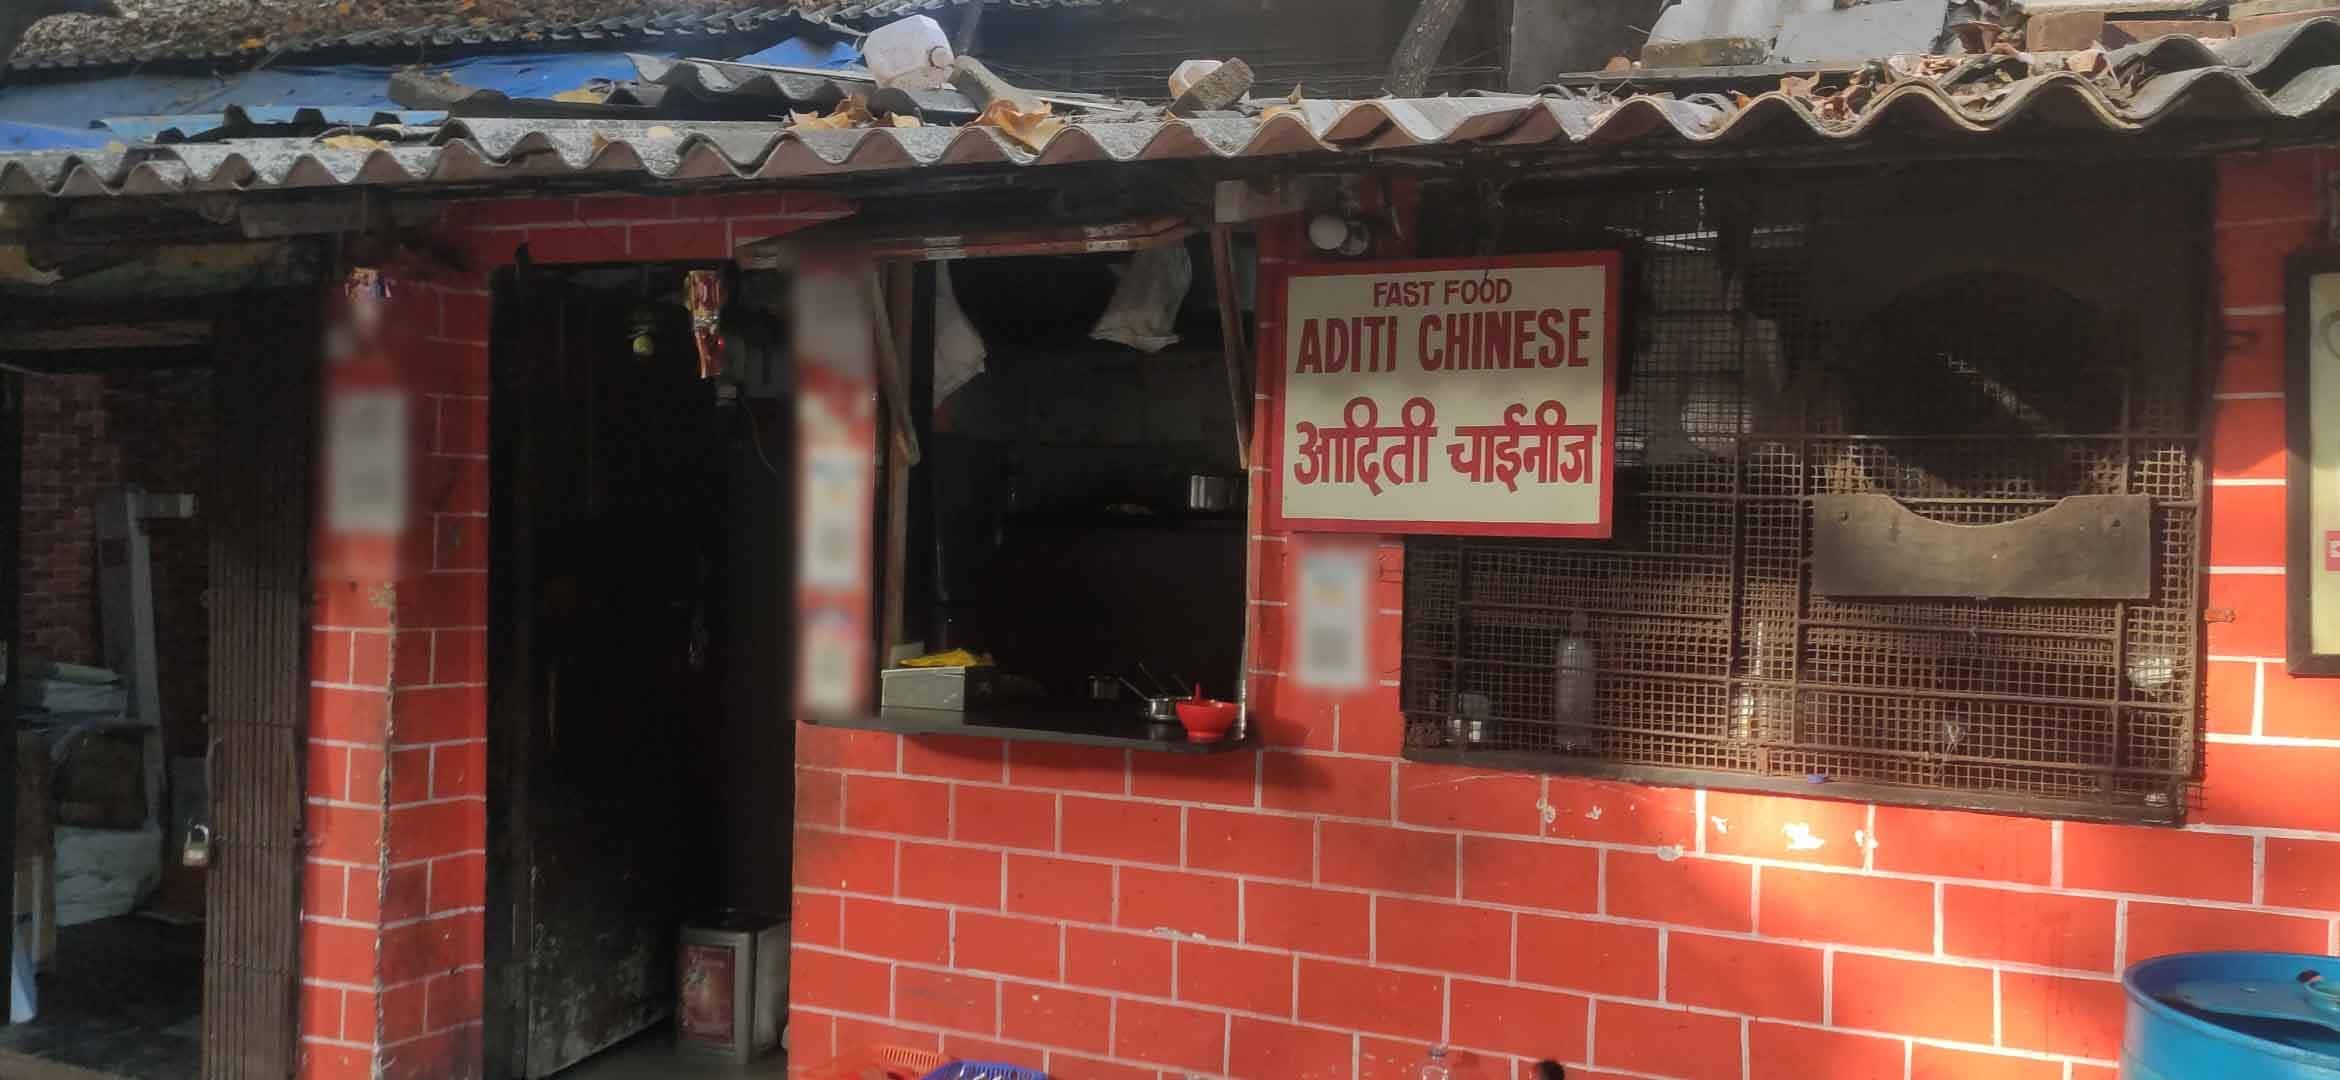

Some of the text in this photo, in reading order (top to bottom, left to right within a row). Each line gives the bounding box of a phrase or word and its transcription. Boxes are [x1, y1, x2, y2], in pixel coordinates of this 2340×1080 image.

[1374, 278, 1513, 307] FAST FOOD
[1296, 308, 1592, 374] ADITI CHINESE
[1293, 396, 1598, 496] आदिती चाईनीज
